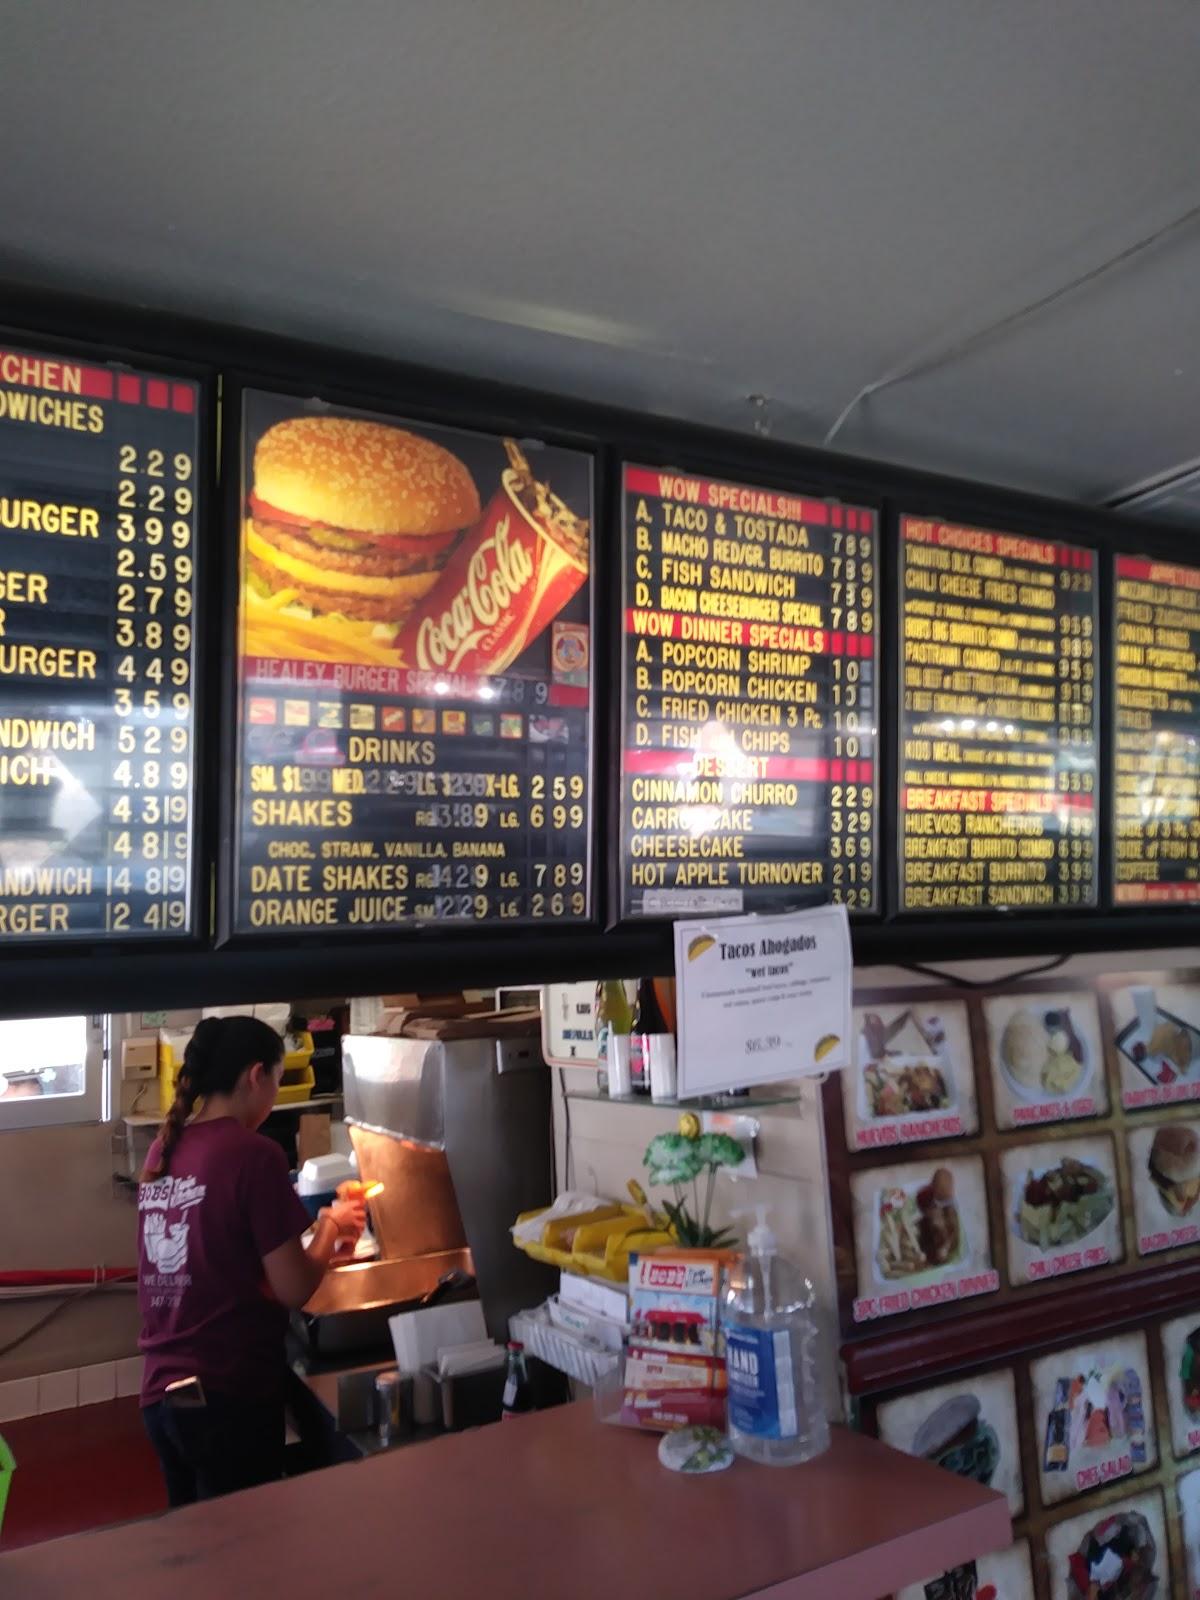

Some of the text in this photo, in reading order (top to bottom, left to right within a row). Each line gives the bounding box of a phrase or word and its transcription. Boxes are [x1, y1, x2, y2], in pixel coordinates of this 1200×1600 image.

[0, 354, 82, 395] CHEN
[659, 475, 700, 503] WOW
[636, 499, 652, 523] A.
[662, 503, 708, 532] TACO
[715, 513, 726, 535] &
[734, 515, 810, 548] TOSTADA
[636, 527, 652, 551] B.
[661, 531, 708, 559] MACHO
[769, 547, 824, 577] BURRITO
[636, 555, 795, 598] C. FISH SANDWICH
[636, 582, 652, 607] D.
[633, 610, 824, 654] WOW DINNER SPECIALS
[636, 639, 652, 663] A.
[662, 642, 741, 671] POPCORN
[748, 651, 811, 676] SHRIMP
[256, 659, 326, 687] HEALEY
[335, 664, 399, 692] BURGER
[636, 667, 652, 690] B.
[662, 669, 740, 697] POPCORN
[747, 677, 817, 704] CHICKEN
[636, 695, 652, 718] C.
[661, 697, 709, 721] FRIED
[716, 701, 781, 727] CHICKEN
[787, 705, 798, 728] 3
[349, 736, 435, 766] DRINKS
[636, 723, 652, 746] D.
[742, 730, 790, 753] CHIPS
[695, 756, 769, 778] DESRT
[632, 778, 724, 803] CINNAMON
[731, 782, 798, 806] CHURRO
[907, 789, 986, 810] BREAKFAST
[251, 799, 352, 827] SHAKES
[632, 807, 700, 831] CARRO
[905, 813, 961, 835] HUEVOS
[452, 842, 506, 858] BANANA
[631, 835, 744, 858] CHEESECAKE
[905, 837, 968, 859] BREAKFAST
[251, 865, 311, 892] DATE
[322, 864, 409, 890] SHAKES
[632, 863, 667, 886] HOT
[675, 863, 729, 885] APPLE
[737, 862, 823, 885] TURNOVER
[905, 861, 985, 882] BREAKFAST
[989, 862, 1046, 882] BURRITO
[905, 885, 985, 907] BREAKFAST
[988, 884, 1053, 905] SANDWICH
[250, 898, 338, 927] ORANGE
[348, 896, 408, 923] JUICE
[719, 942, 755, 961] Tacos
[727, 1345, 758, 1375] HAND
